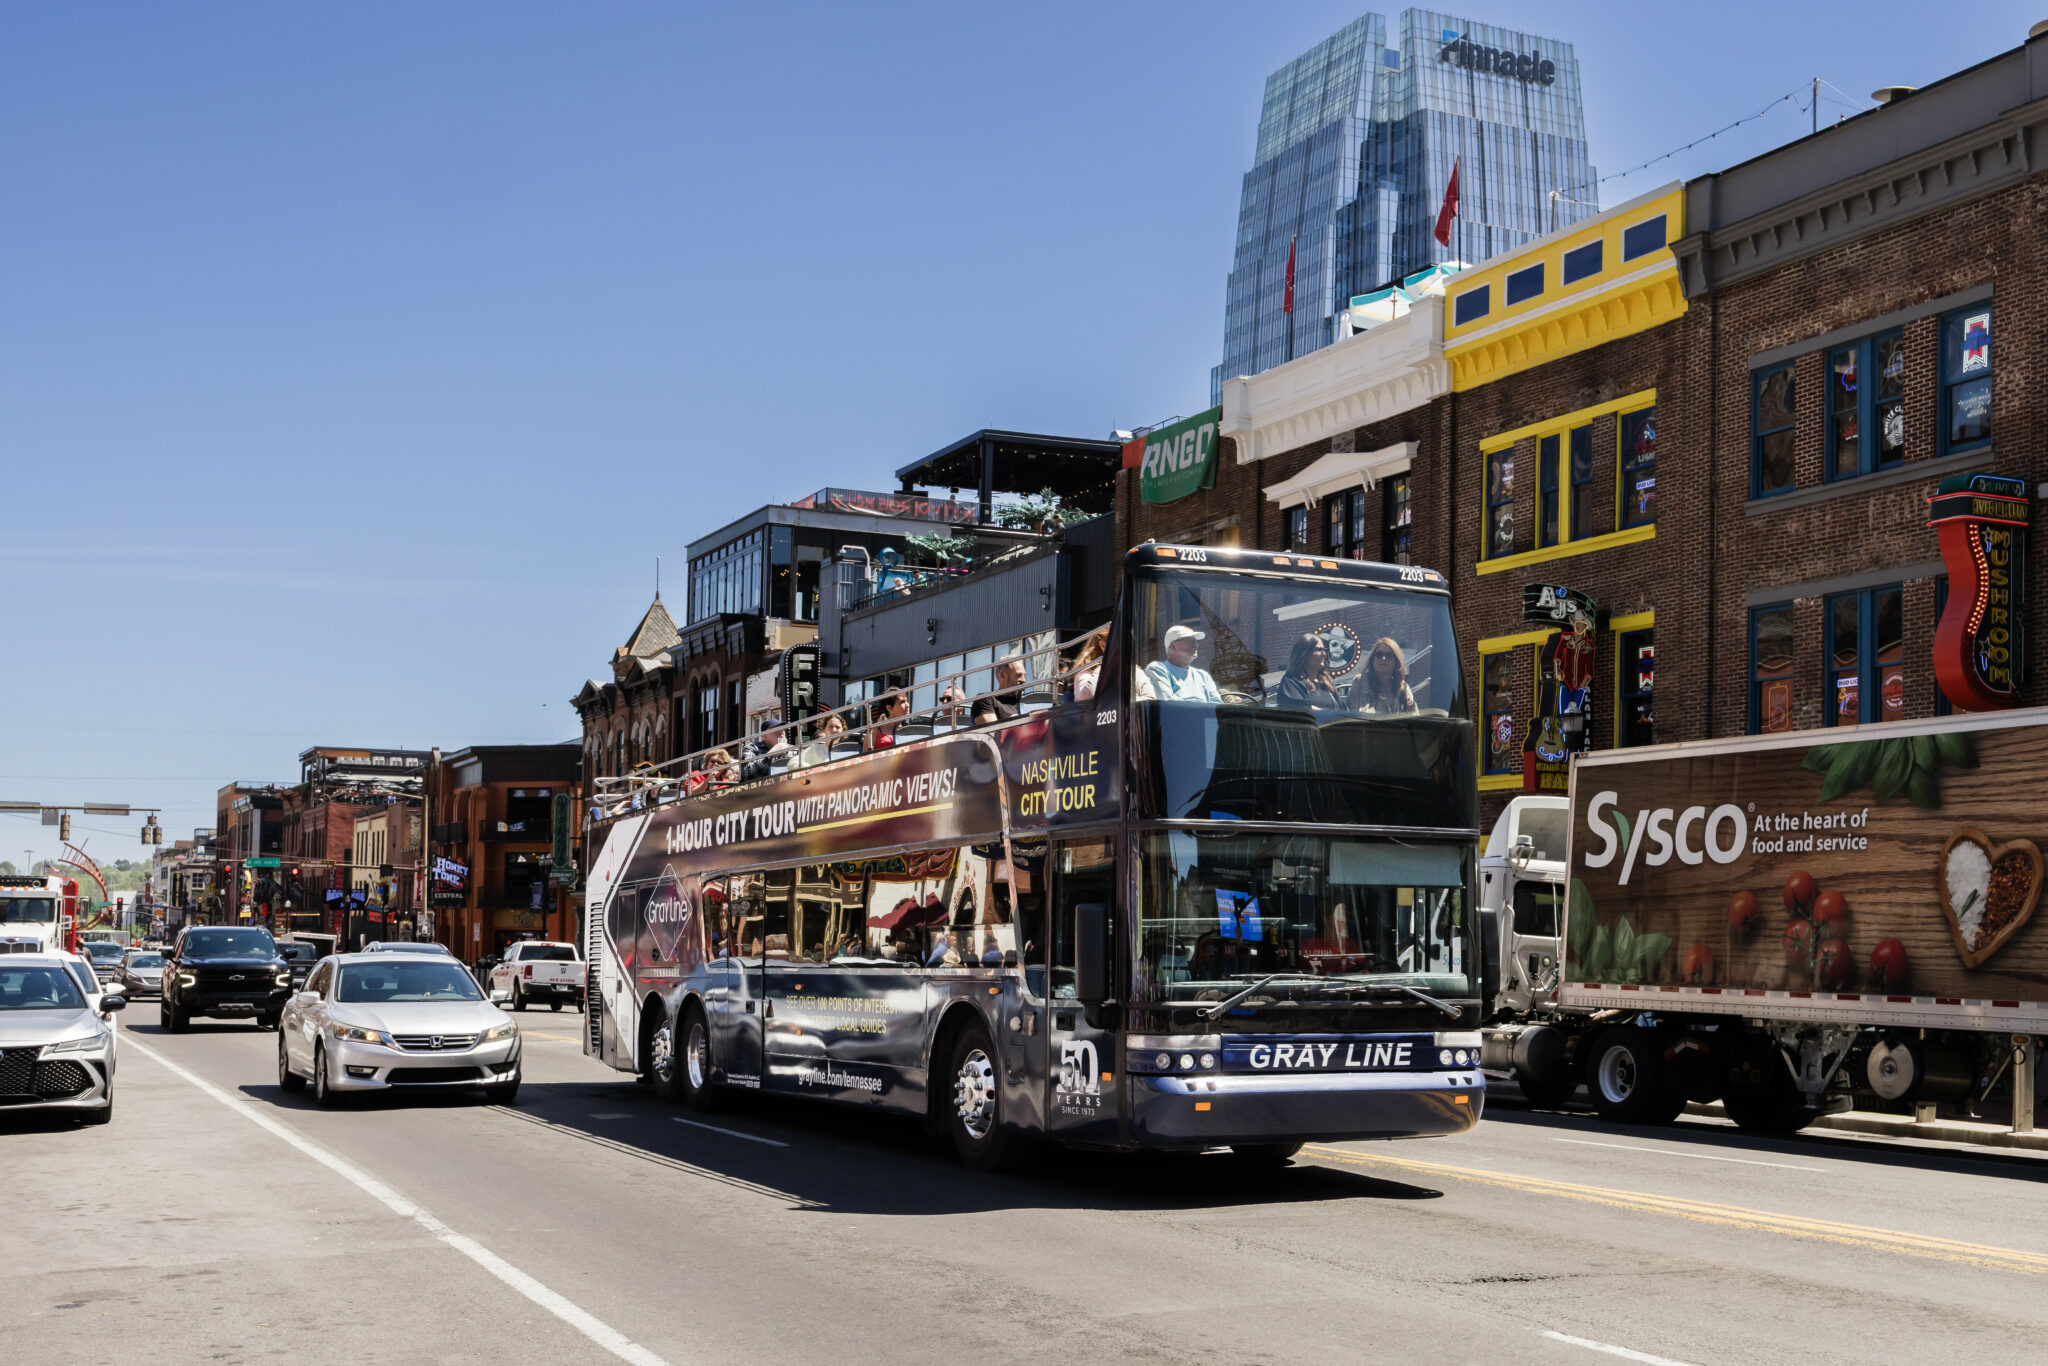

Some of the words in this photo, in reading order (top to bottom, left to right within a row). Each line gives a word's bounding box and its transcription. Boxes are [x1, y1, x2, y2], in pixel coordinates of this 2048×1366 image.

[1441, 29, 1555, 86] Pinnacle
[1140, 422, 1215, 479] RNGD
[1973, 499, 2028, 520] MELLOW
[1179, 548, 1207, 562] 2203
[1400, 568, 1424, 582] 2203
[1989, 529, 2010, 683] MUSHROOM
[1096, 710, 1117, 726] 2203
[1021, 750, 1099, 786] NASHVILLE
[1021, 790, 1051, 816] CITY
[1054, 784, 1096, 812] TOUR
[666, 818, 712, 855] 1-HOUR
[716, 810, 748, 845] CITY
[753, 800, 795, 838] TOUR
[797, 797, 824, 823] WITH
[827, 779, 902, 819] PANORAMIC
[907, 768, 958, 804] VIEWS!
[1753, 814, 1771, 832] At
[1774, 812, 1800, 831] the
[1803, 810, 1847, 831] heart
[1850, 808, 1869, 828] of
[1752, 836, 1783, 854] food
[1786, 835, 1813, 852] and
[1817, 833, 1868, 851] service
[436, 856, 469, 876] HONKY
[432, 868, 460, 886] TONK
[786, 995, 798, 1009] SEE
[799, 996, 816, 1010] OVER
[817, 996, 828, 1011] 100
[828, 997, 852, 1012] POINTS
[853, 998, 863, 1012] OF
[837, 1017, 860, 1032] LOCAL
[860, 1018, 887, 1034] GUIDES
[1249, 1043, 1338, 1068] GRAY
[1345, 1042, 1414, 1067] LINE
[1060, 1039, 1099, 1093] 50
[798, 1066, 883, 1092] grayline.com/tennessee
[1056, 1094, 1101, 1107] YEARS
[1061, 1105, 1080, 1115] SINCE
[1081, 1107, 1095, 1116] 1973
